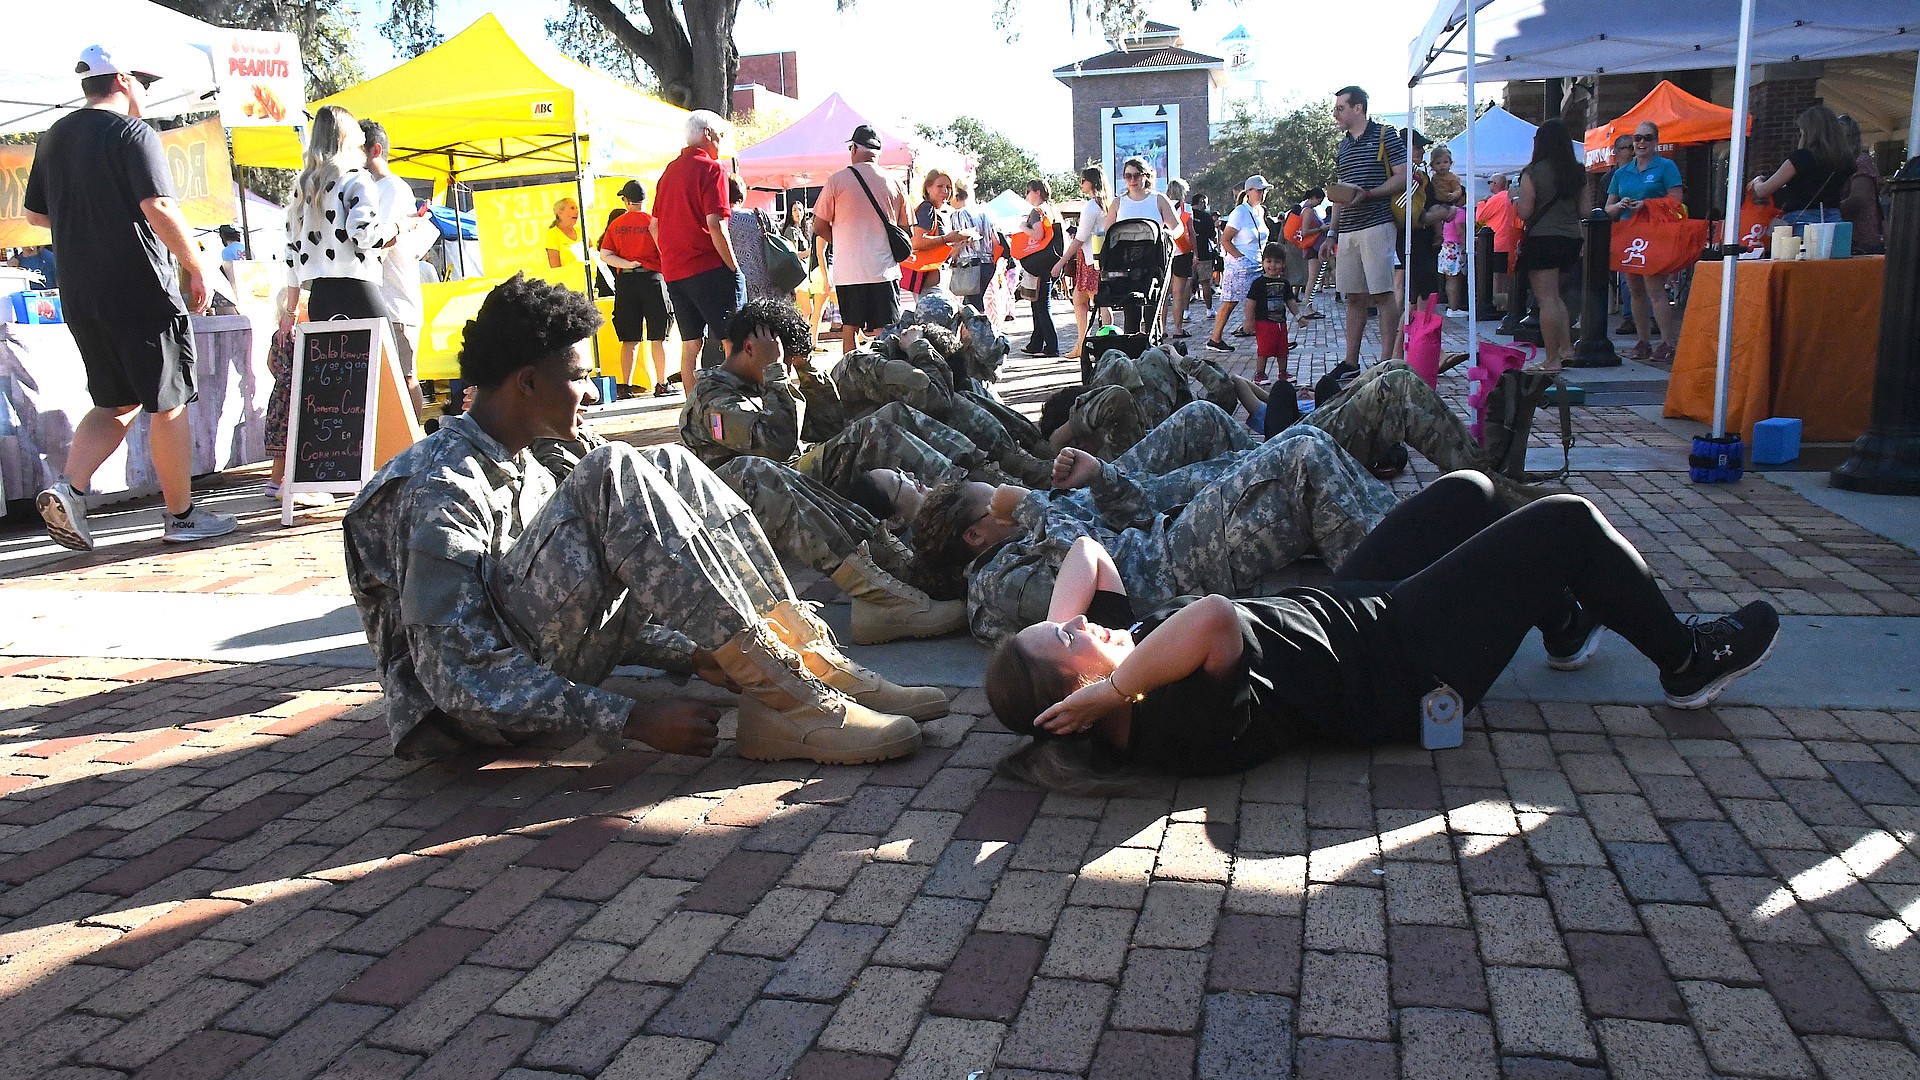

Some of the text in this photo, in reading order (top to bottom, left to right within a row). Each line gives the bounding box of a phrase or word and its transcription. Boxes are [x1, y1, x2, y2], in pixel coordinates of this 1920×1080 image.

[228, 57, 289, 77] PEANUTS
[534, 103, 553, 113] ABC
[301, 441, 330, 461] CORN
[172, 521, 195, 529] HOKA
